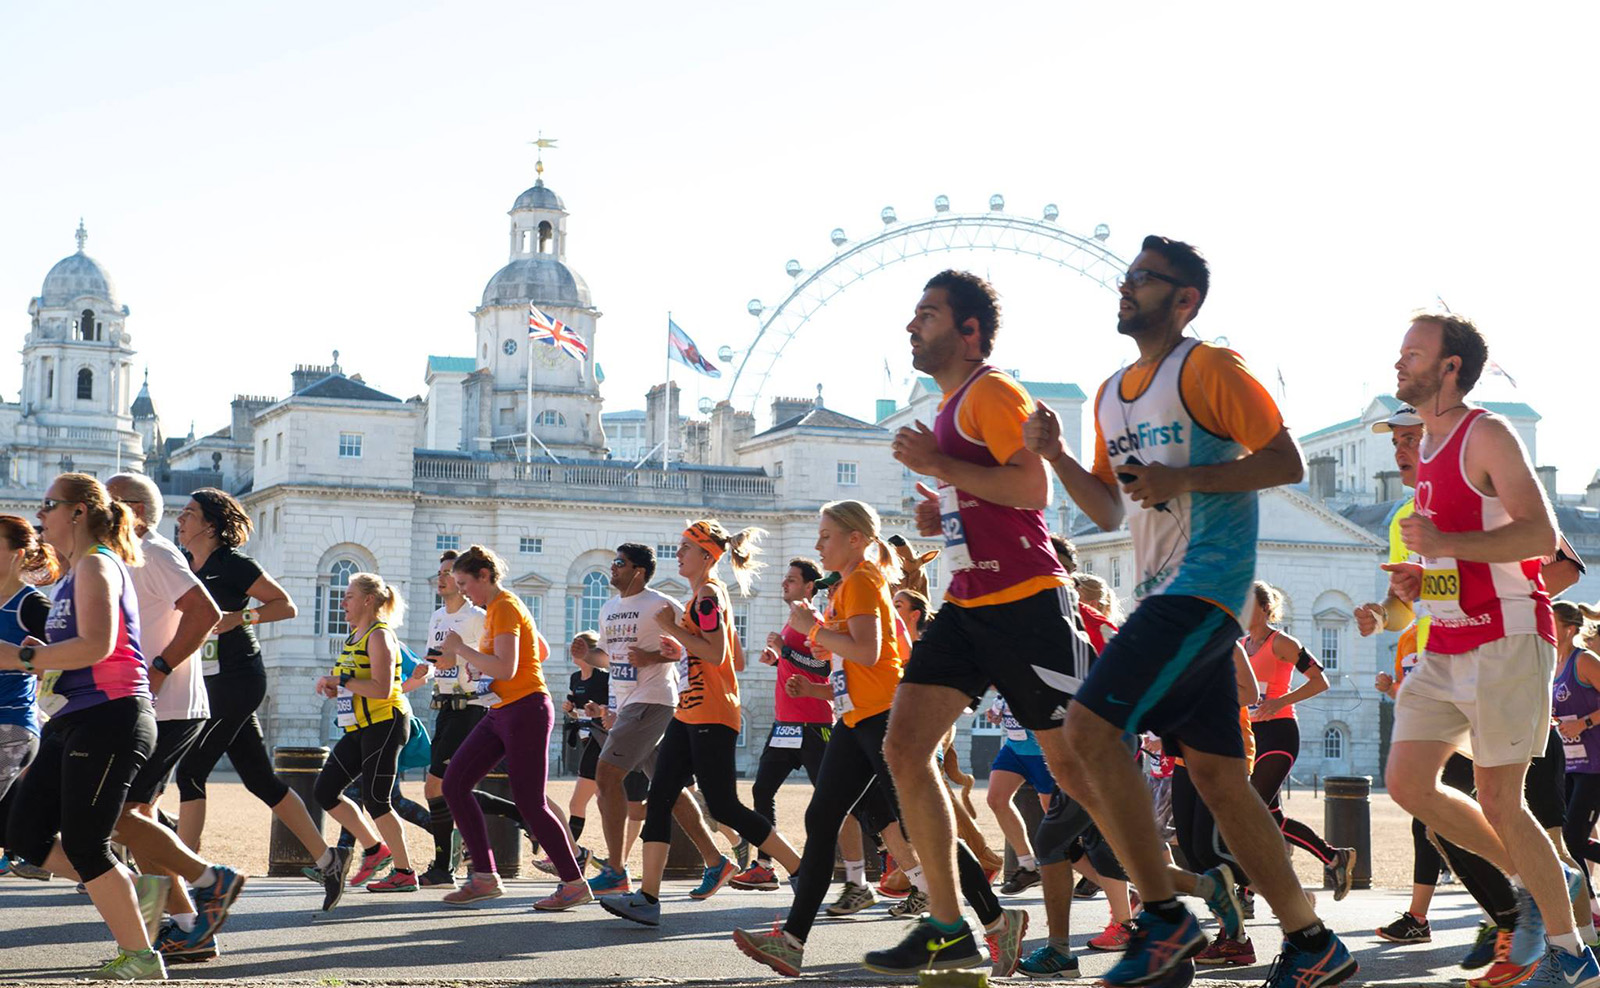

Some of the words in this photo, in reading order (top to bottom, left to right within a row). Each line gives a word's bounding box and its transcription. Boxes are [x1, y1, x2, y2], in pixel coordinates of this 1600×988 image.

[606, 611, 640, 621] ASHWIN
[612, 666, 634, 679] 2741
[776, 726, 802, 735] 15054
